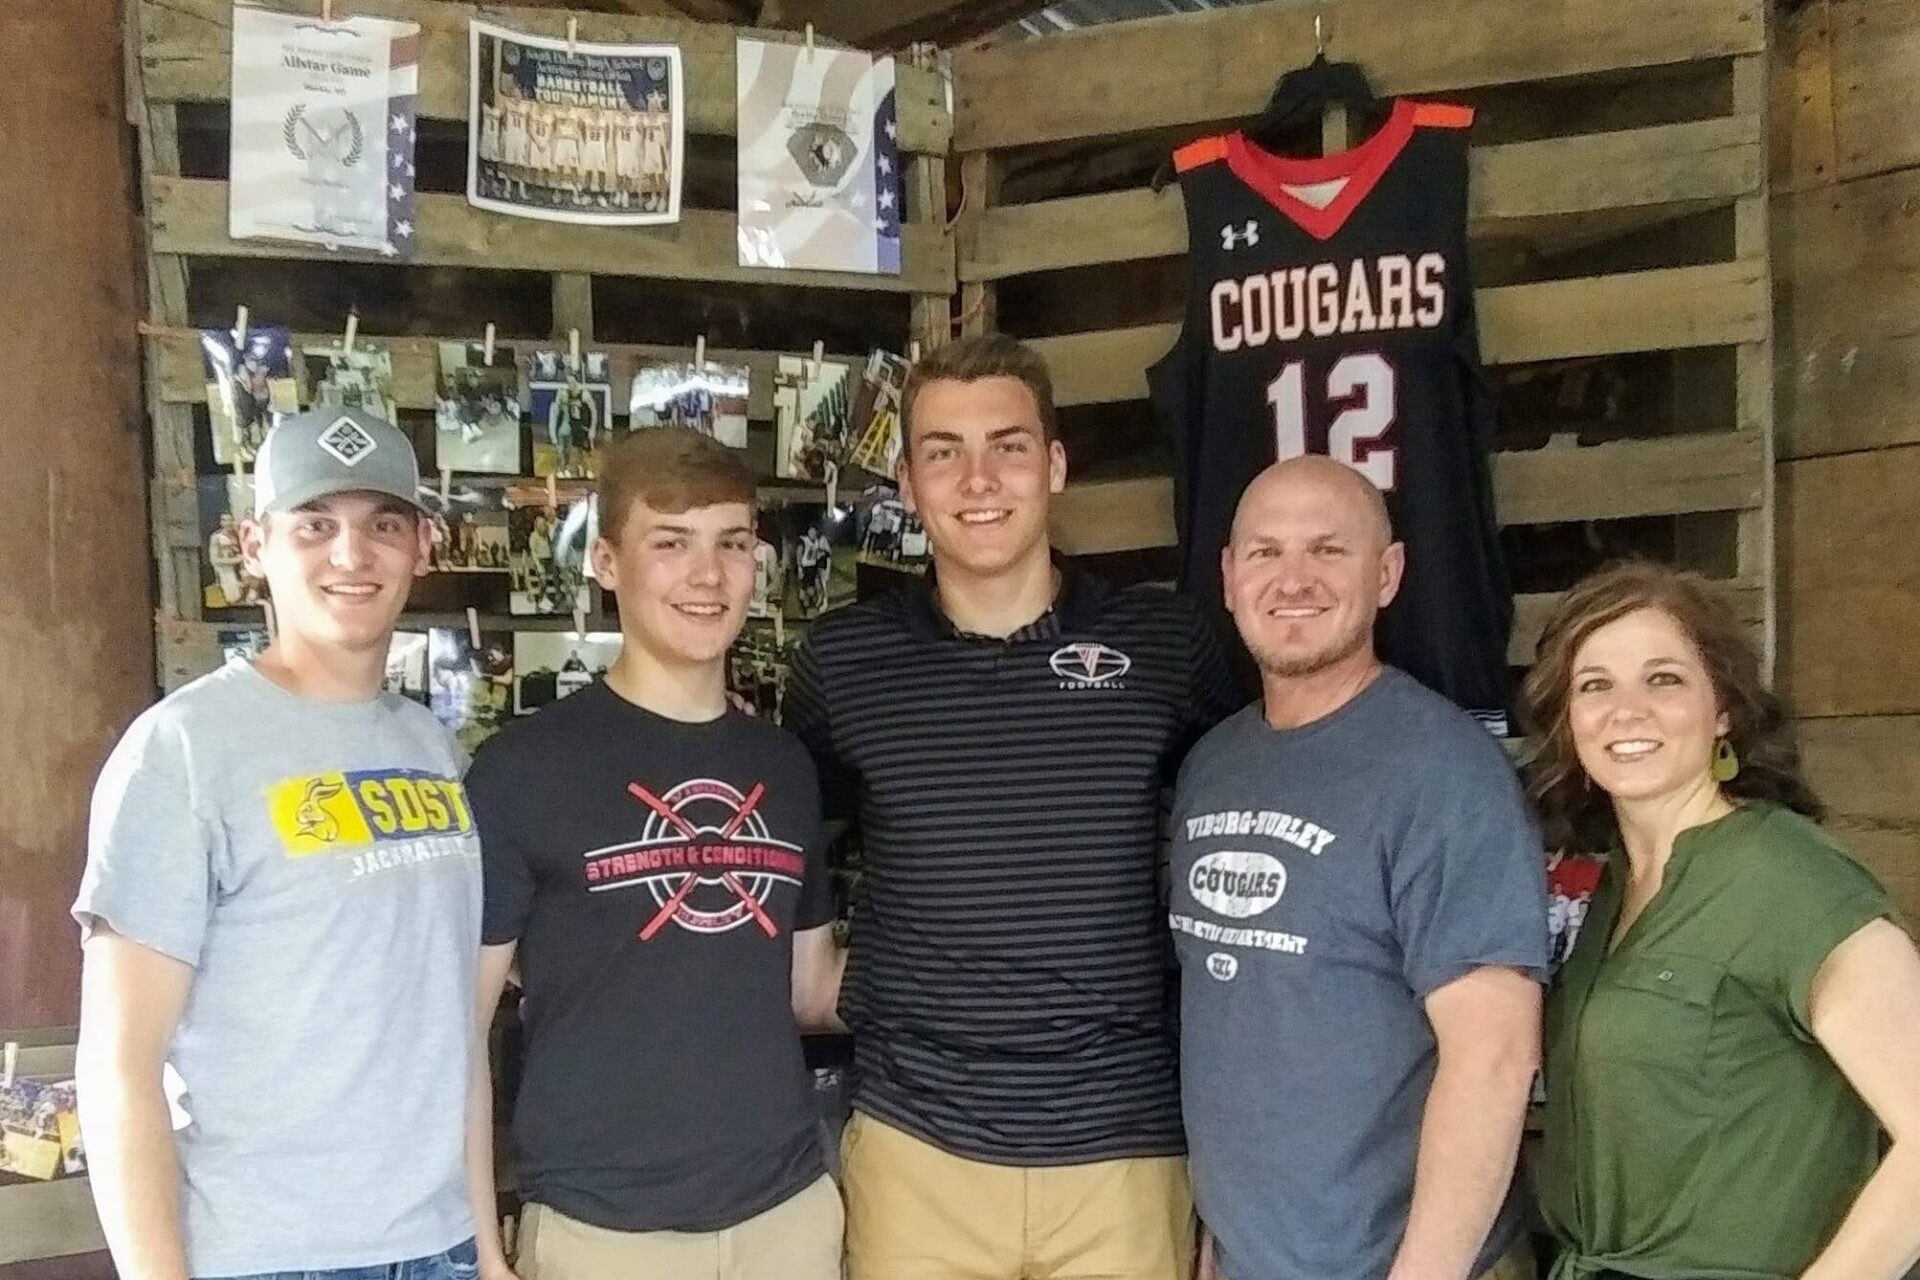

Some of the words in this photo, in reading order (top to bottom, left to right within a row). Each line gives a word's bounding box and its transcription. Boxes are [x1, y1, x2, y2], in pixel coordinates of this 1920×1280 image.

[282, 55, 329, 72] Allstar
[331, 62, 372, 79] Game
[534, 87, 628, 110] TOUNAMENT
[1210, 252, 1446, 352] COUGARS
[1266, 352, 1395, 490] 12
[1059, 680, 1126, 691] FOOTBALL
[585, 847, 685, 883] STRENGTH
[686, 846, 699, 865] &
[1193, 864, 1281, 899] COUGARS
